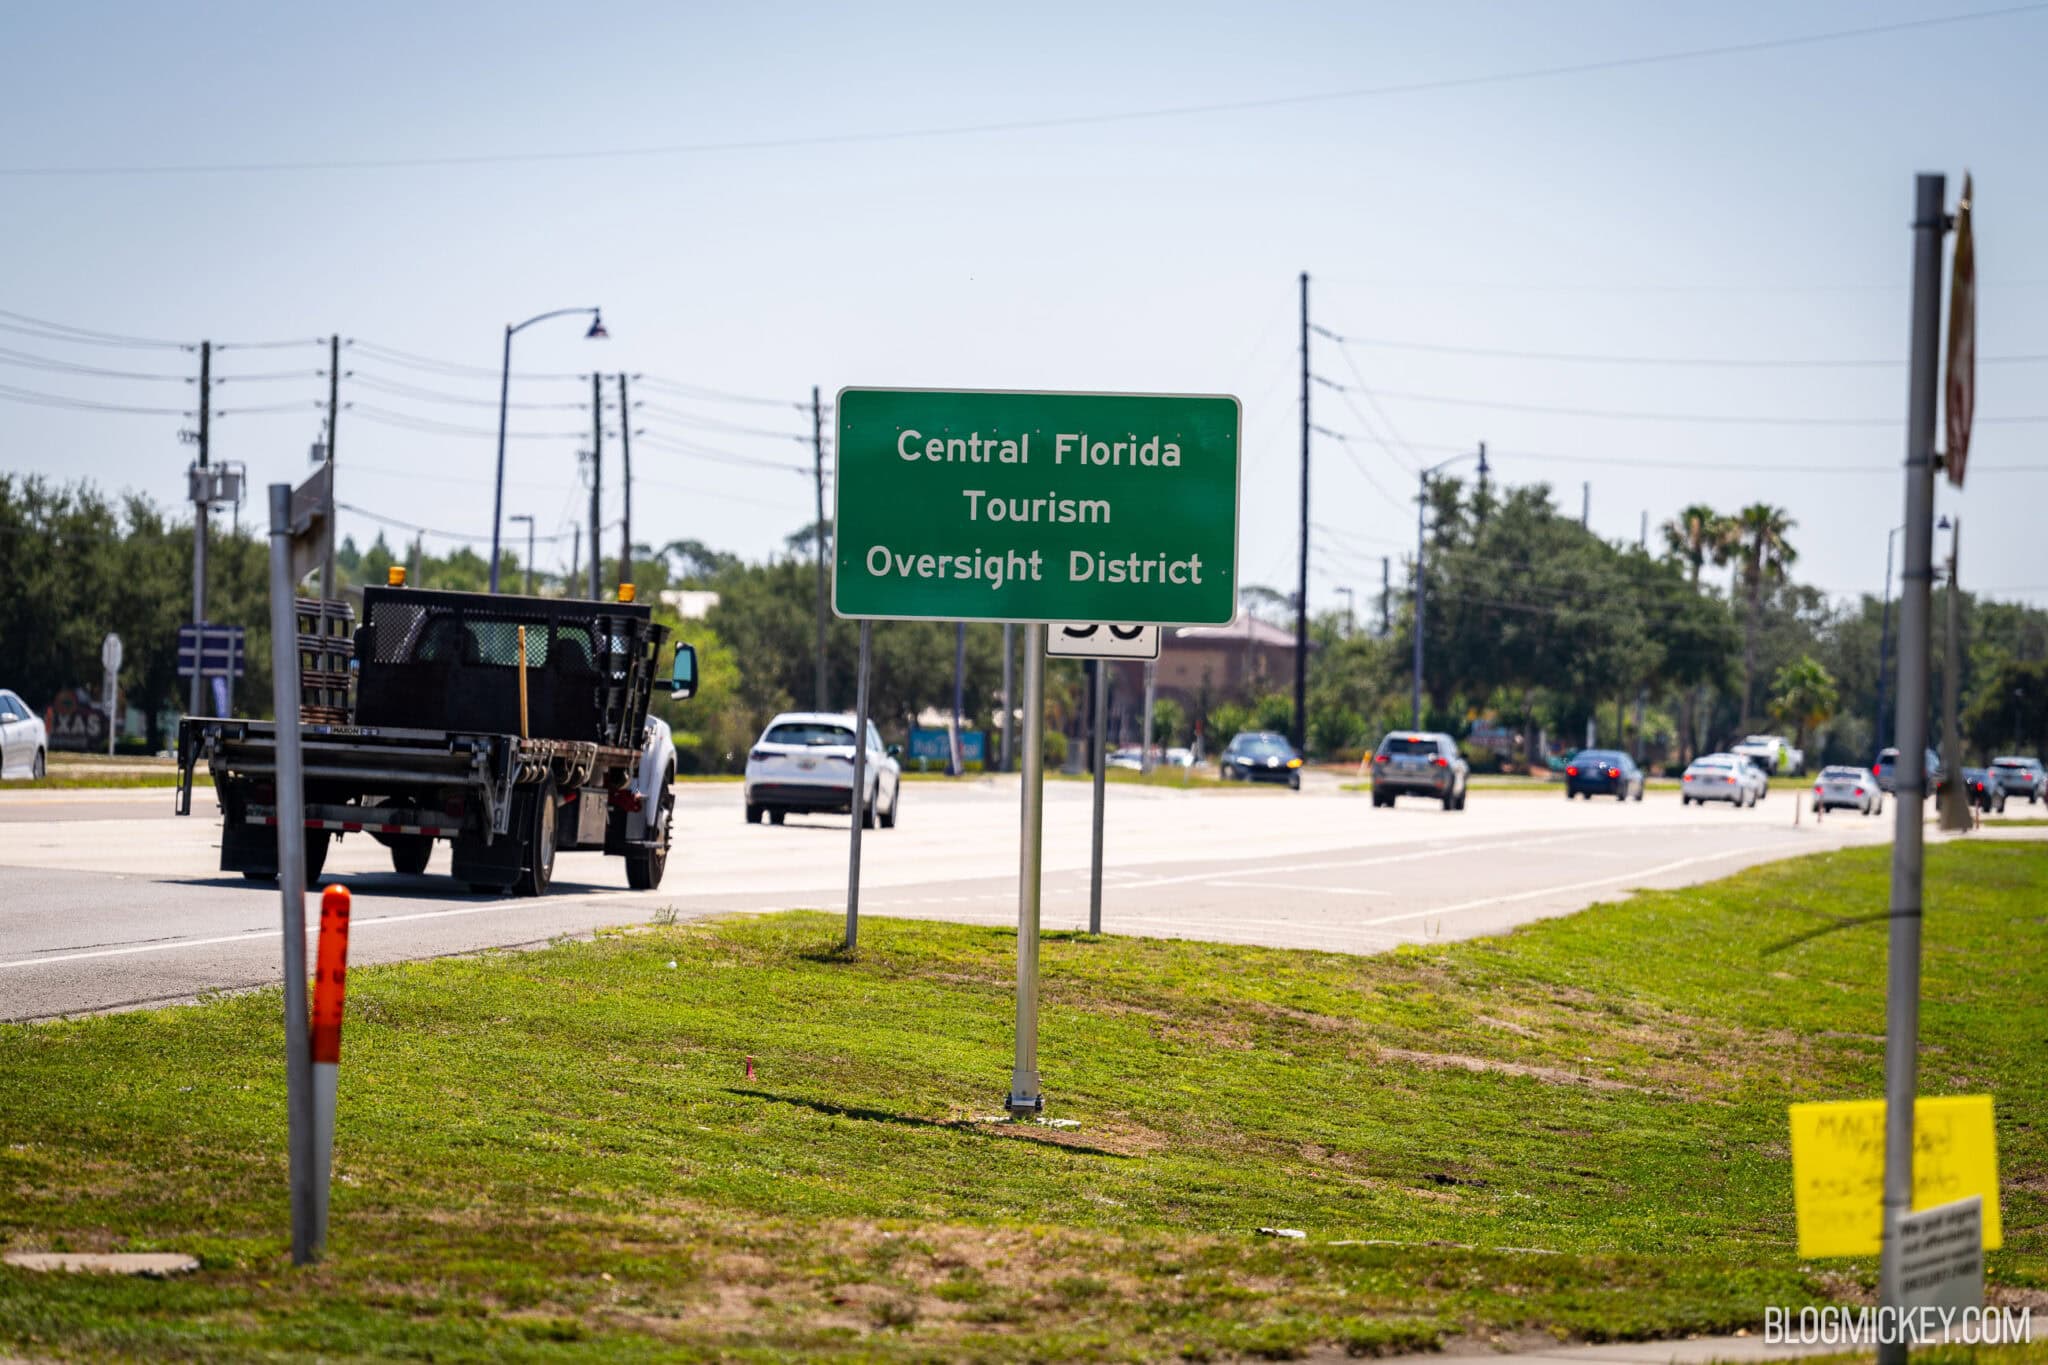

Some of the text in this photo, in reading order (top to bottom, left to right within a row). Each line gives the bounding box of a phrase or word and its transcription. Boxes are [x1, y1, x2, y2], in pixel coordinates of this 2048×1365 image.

[897, 429, 1181, 467] Central Florida
[962, 489, 1111, 524] Tourism
[866, 545, 1203, 590] Oversight District
